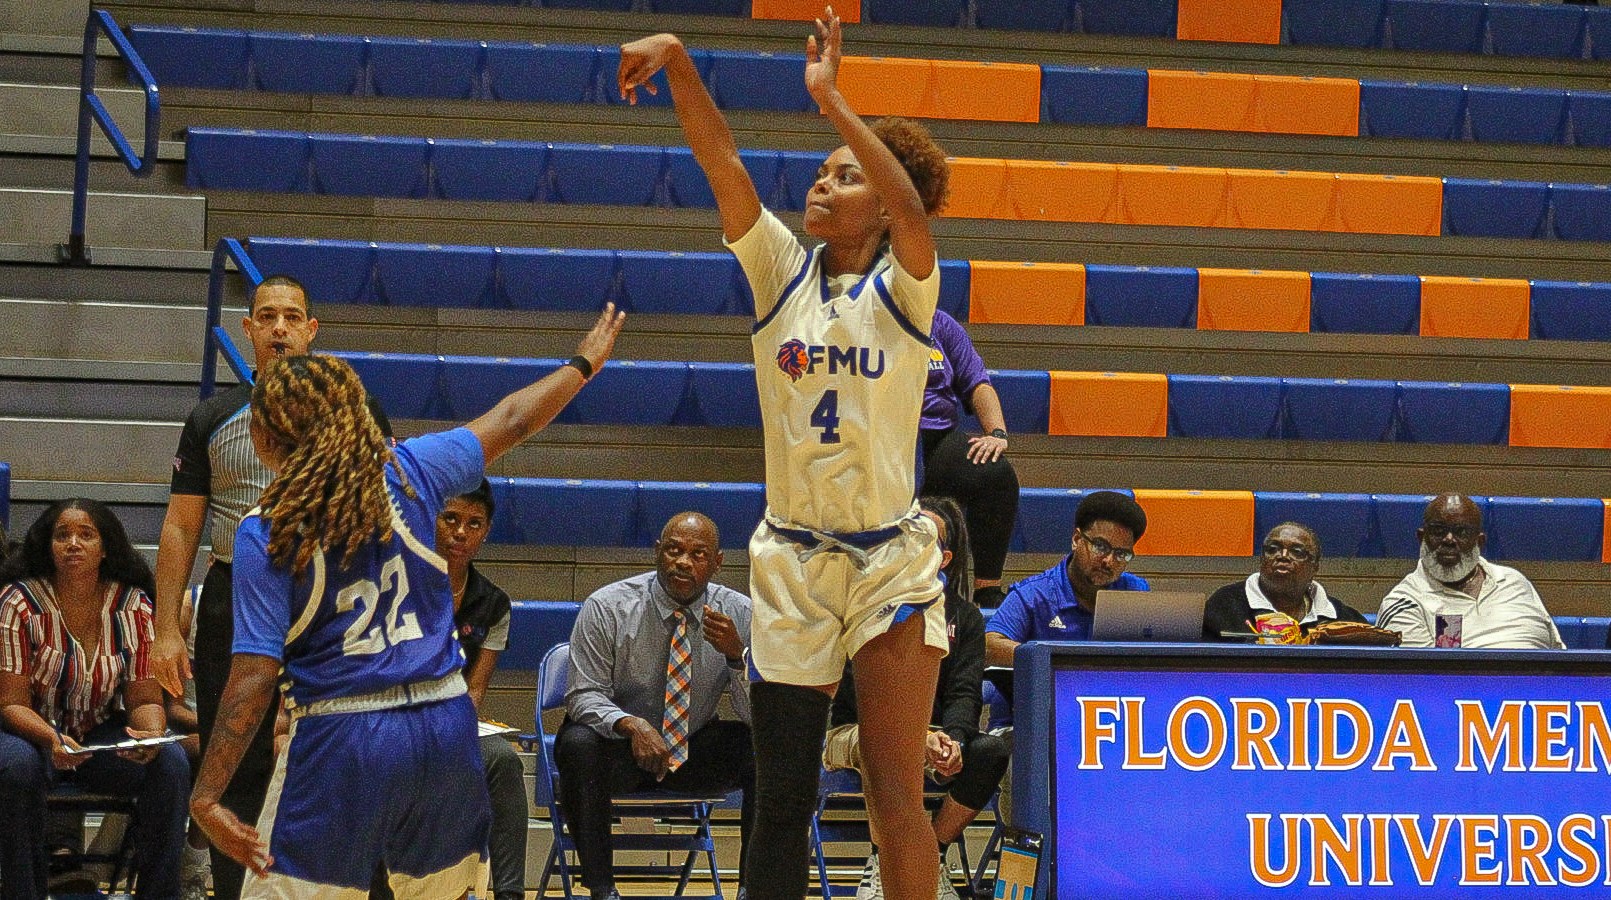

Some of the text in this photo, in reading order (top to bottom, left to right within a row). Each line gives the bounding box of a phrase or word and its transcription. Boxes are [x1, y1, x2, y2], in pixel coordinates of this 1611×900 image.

[806, 345, 885, 379] FMU
[810, 389, 841, 444] 4
[336, 554, 424, 656] 22
[1076, 695, 1438, 771] FLORIDA
